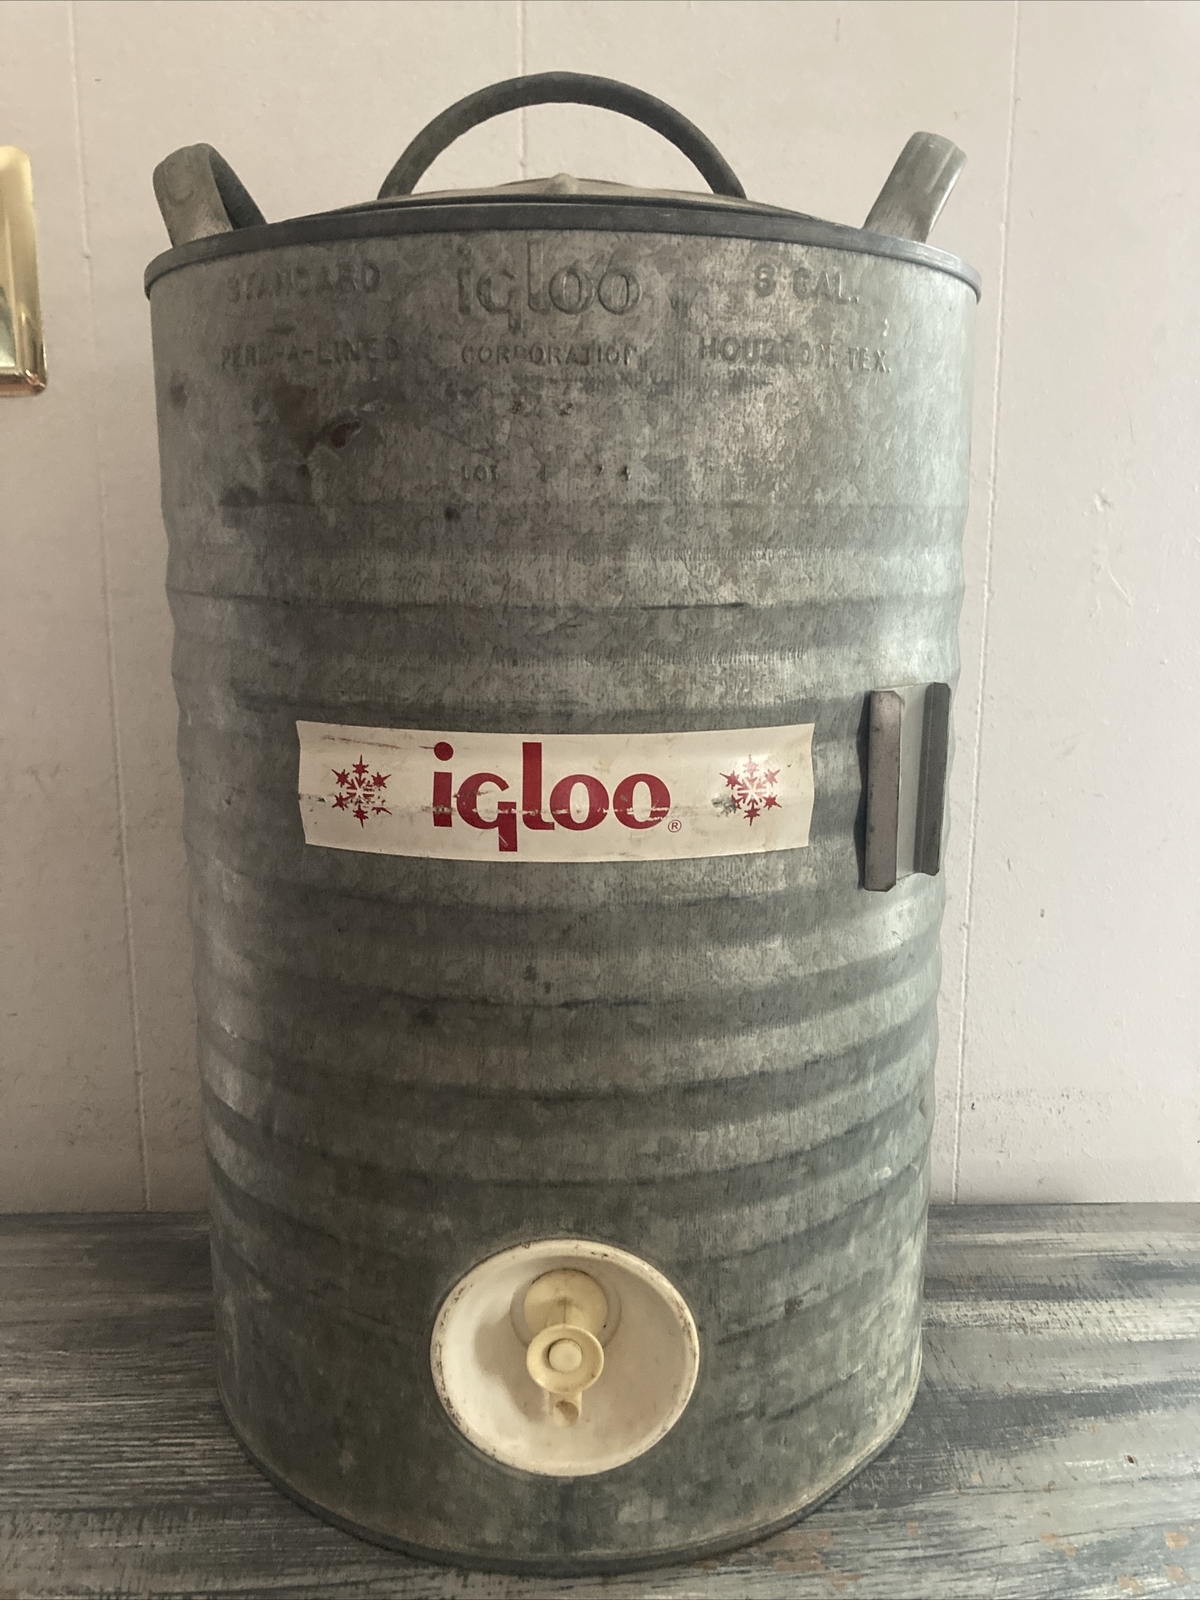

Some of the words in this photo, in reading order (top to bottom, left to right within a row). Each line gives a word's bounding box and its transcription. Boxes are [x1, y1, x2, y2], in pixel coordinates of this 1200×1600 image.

[461, 342, 638, 366] CORPORATION
[848, 346, 891, 374] TEX.
[432, 741, 671, 852] igloo
